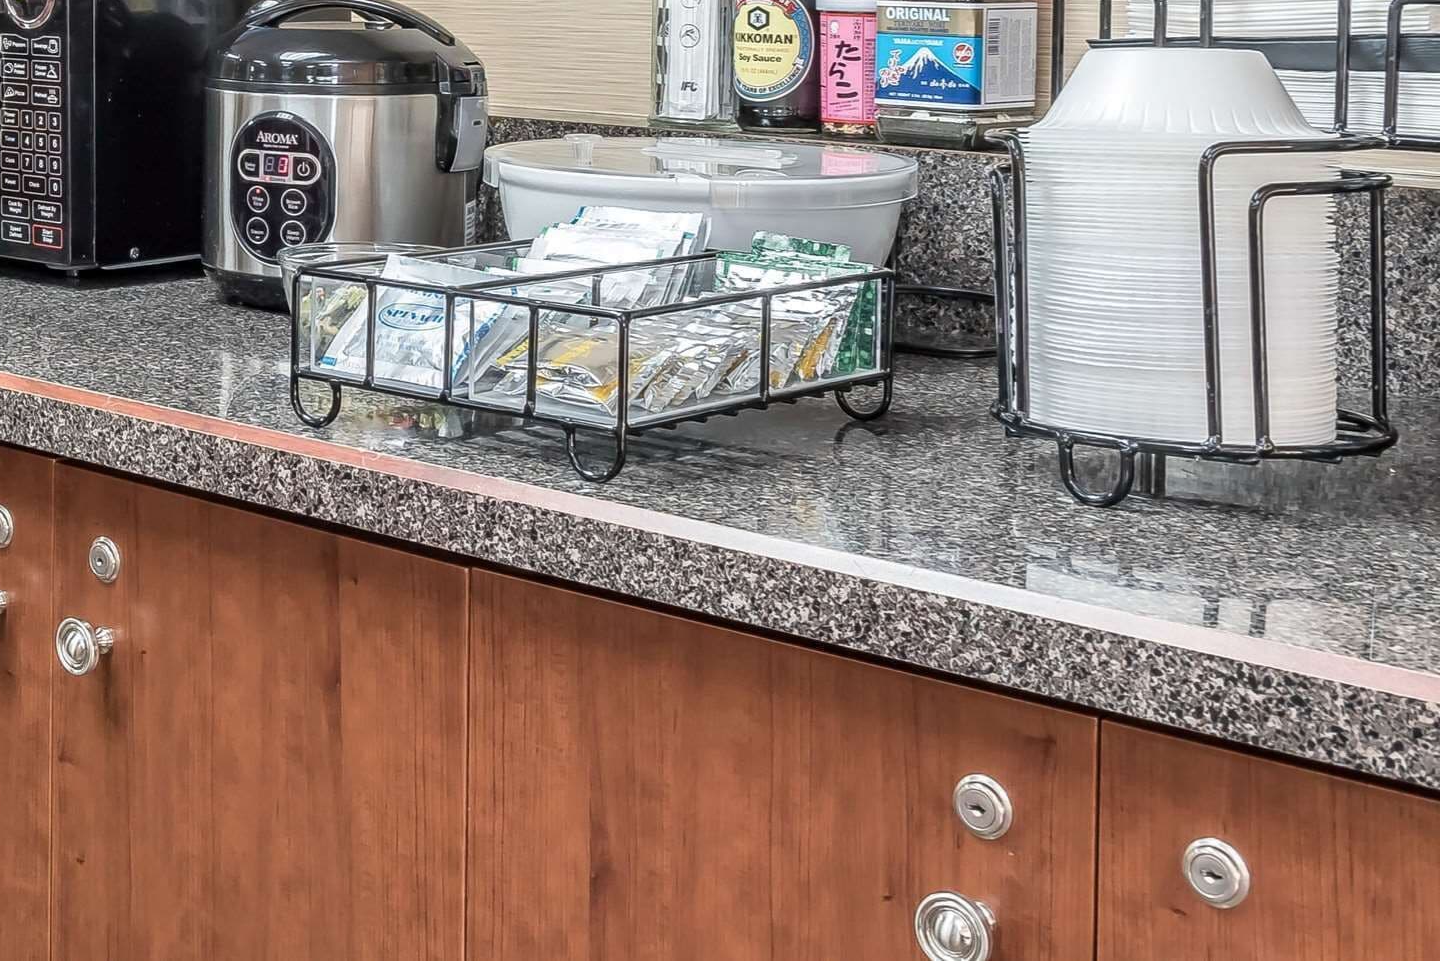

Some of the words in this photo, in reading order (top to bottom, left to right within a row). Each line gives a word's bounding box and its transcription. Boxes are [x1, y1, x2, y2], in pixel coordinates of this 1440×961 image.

[886, 6, 950, 22] ORIGINAL
[738, 52, 752, 62] Soy
[752, 53, 782, 63] Sauce
[256, 130, 296, 145] AROMA
